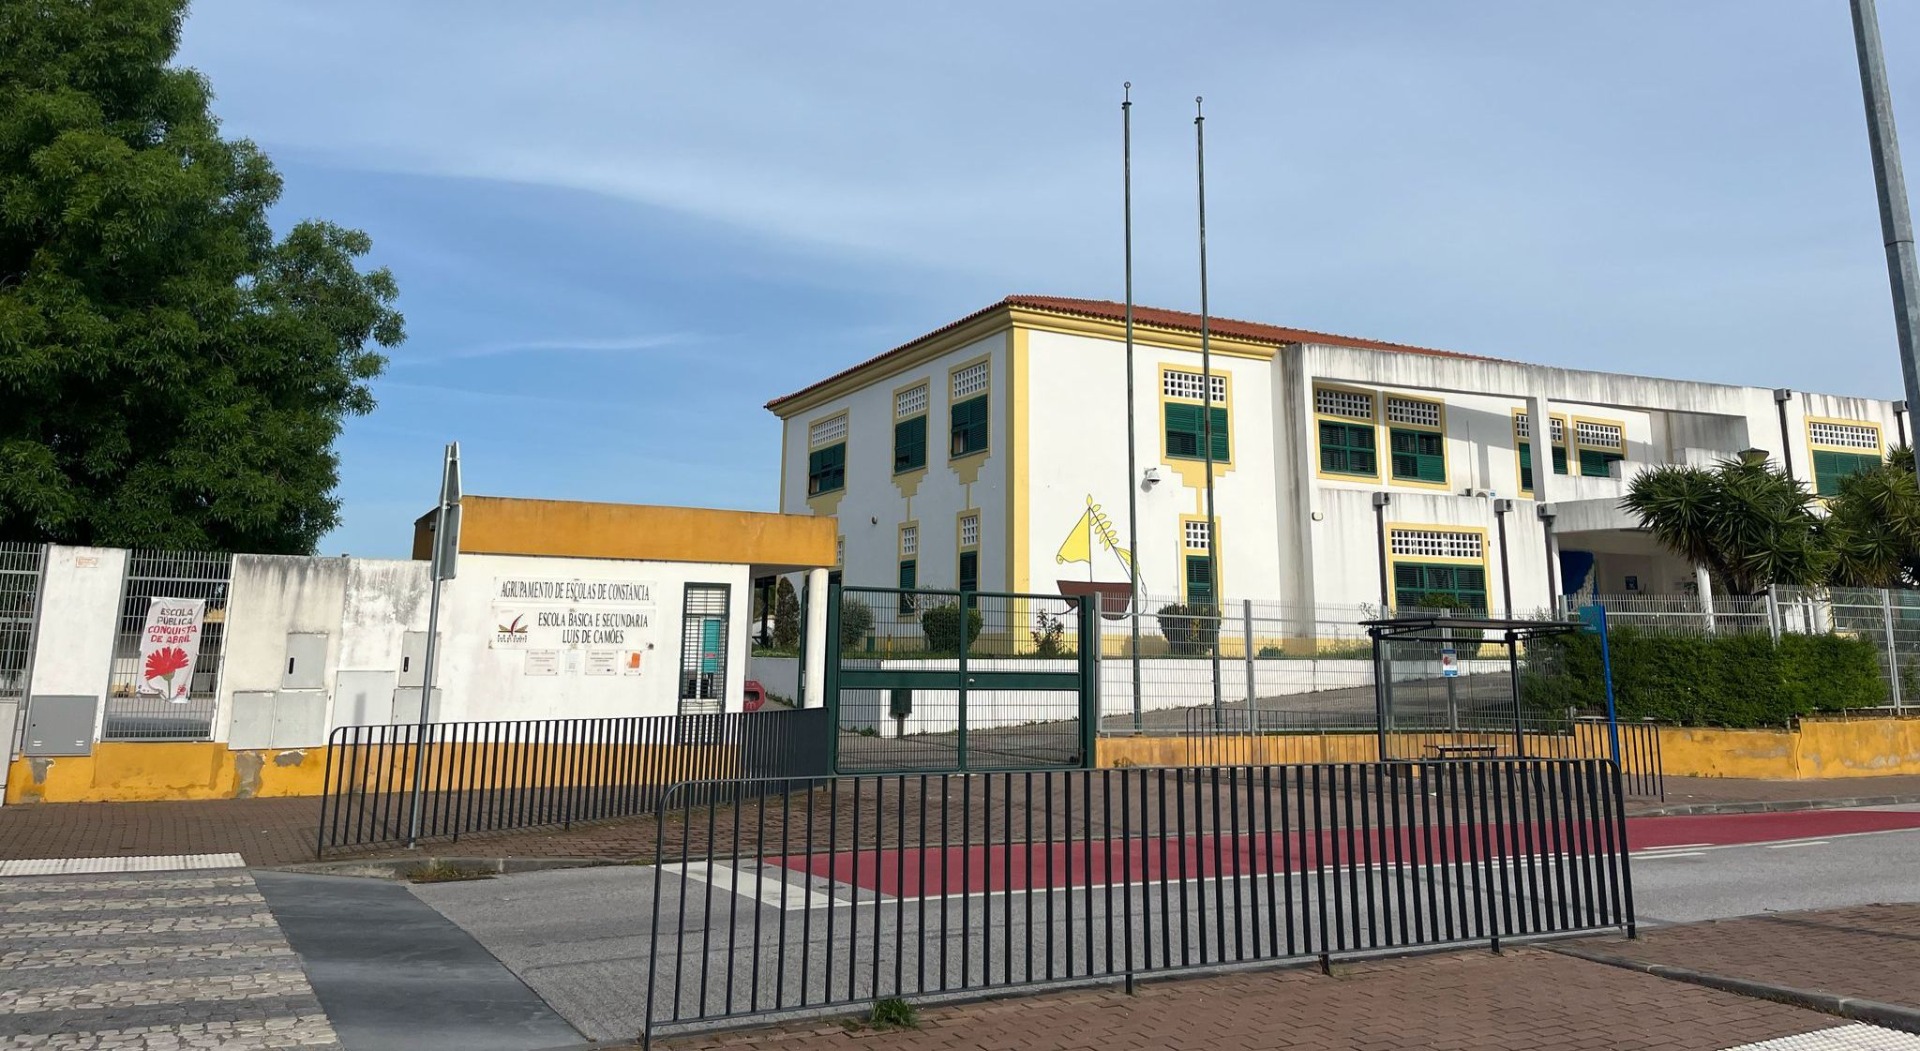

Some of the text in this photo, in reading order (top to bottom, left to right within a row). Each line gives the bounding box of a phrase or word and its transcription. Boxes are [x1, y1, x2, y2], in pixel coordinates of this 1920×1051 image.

[501, 580, 554, 598] AGRUPAMENTO
[555, 582, 564, 598] DE
[565, 582, 596, 599] ESCOLAS
[597, 583, 607, 599] DE
[160, 608, 193, 616] ESCOLA
[538, 612, 566, 627] ESCOLA
[595, 613, 601, 627] E
[148, 625, 197, 635] CONQUISTA
[581, 629, 592, 643] DE
[151, 634, 191, 644] DE ABRIL
